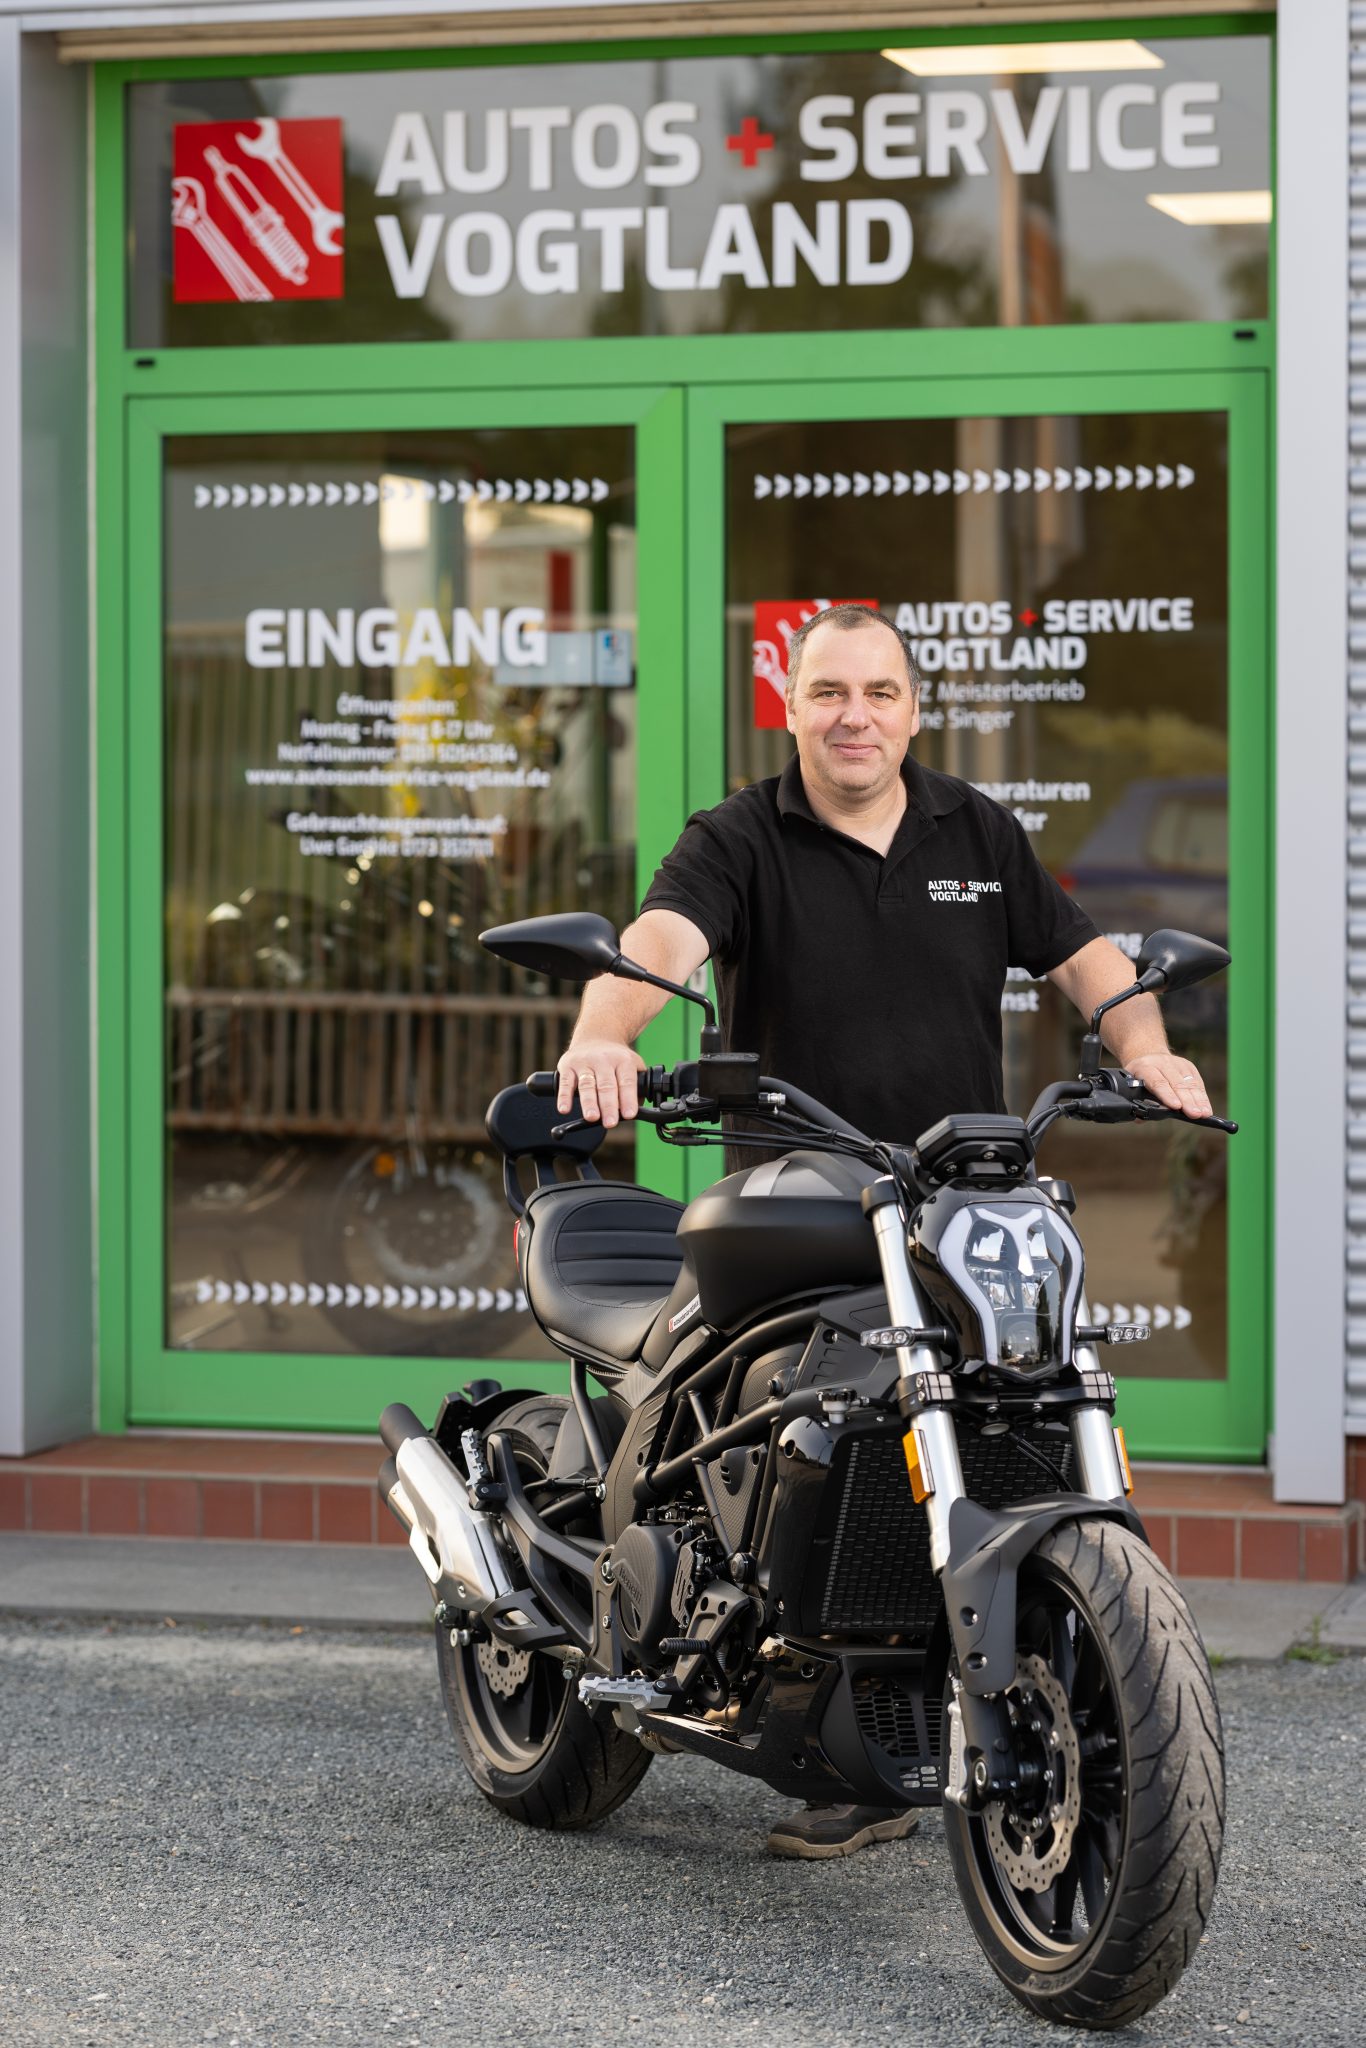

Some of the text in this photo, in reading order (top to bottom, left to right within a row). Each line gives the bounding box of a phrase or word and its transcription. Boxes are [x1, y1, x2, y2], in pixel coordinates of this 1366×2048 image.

[375, 102, 700, 197] AUTOS
[801, 83, 1220, 181] SERVICE
[376, 198, 912, 298] VOGTLAND
[895, 601, 1012, 635] AUTOS
[1043, 598, 1193, 632] SERVICE
[245, 607, 548, 668] EINGANG
[919, 678, 1086, 703] Z Meisterbetrieb
[301, 719, 360, 743] Montag
[373, 719, 429, 742] Freitag
[463, 720, 495, 740] Uhr
[919, 705, 1014, 734] né Singer
[928, 880, 960, 891] AUTOS
[929, 891, 979, 902] VOGTLAND
